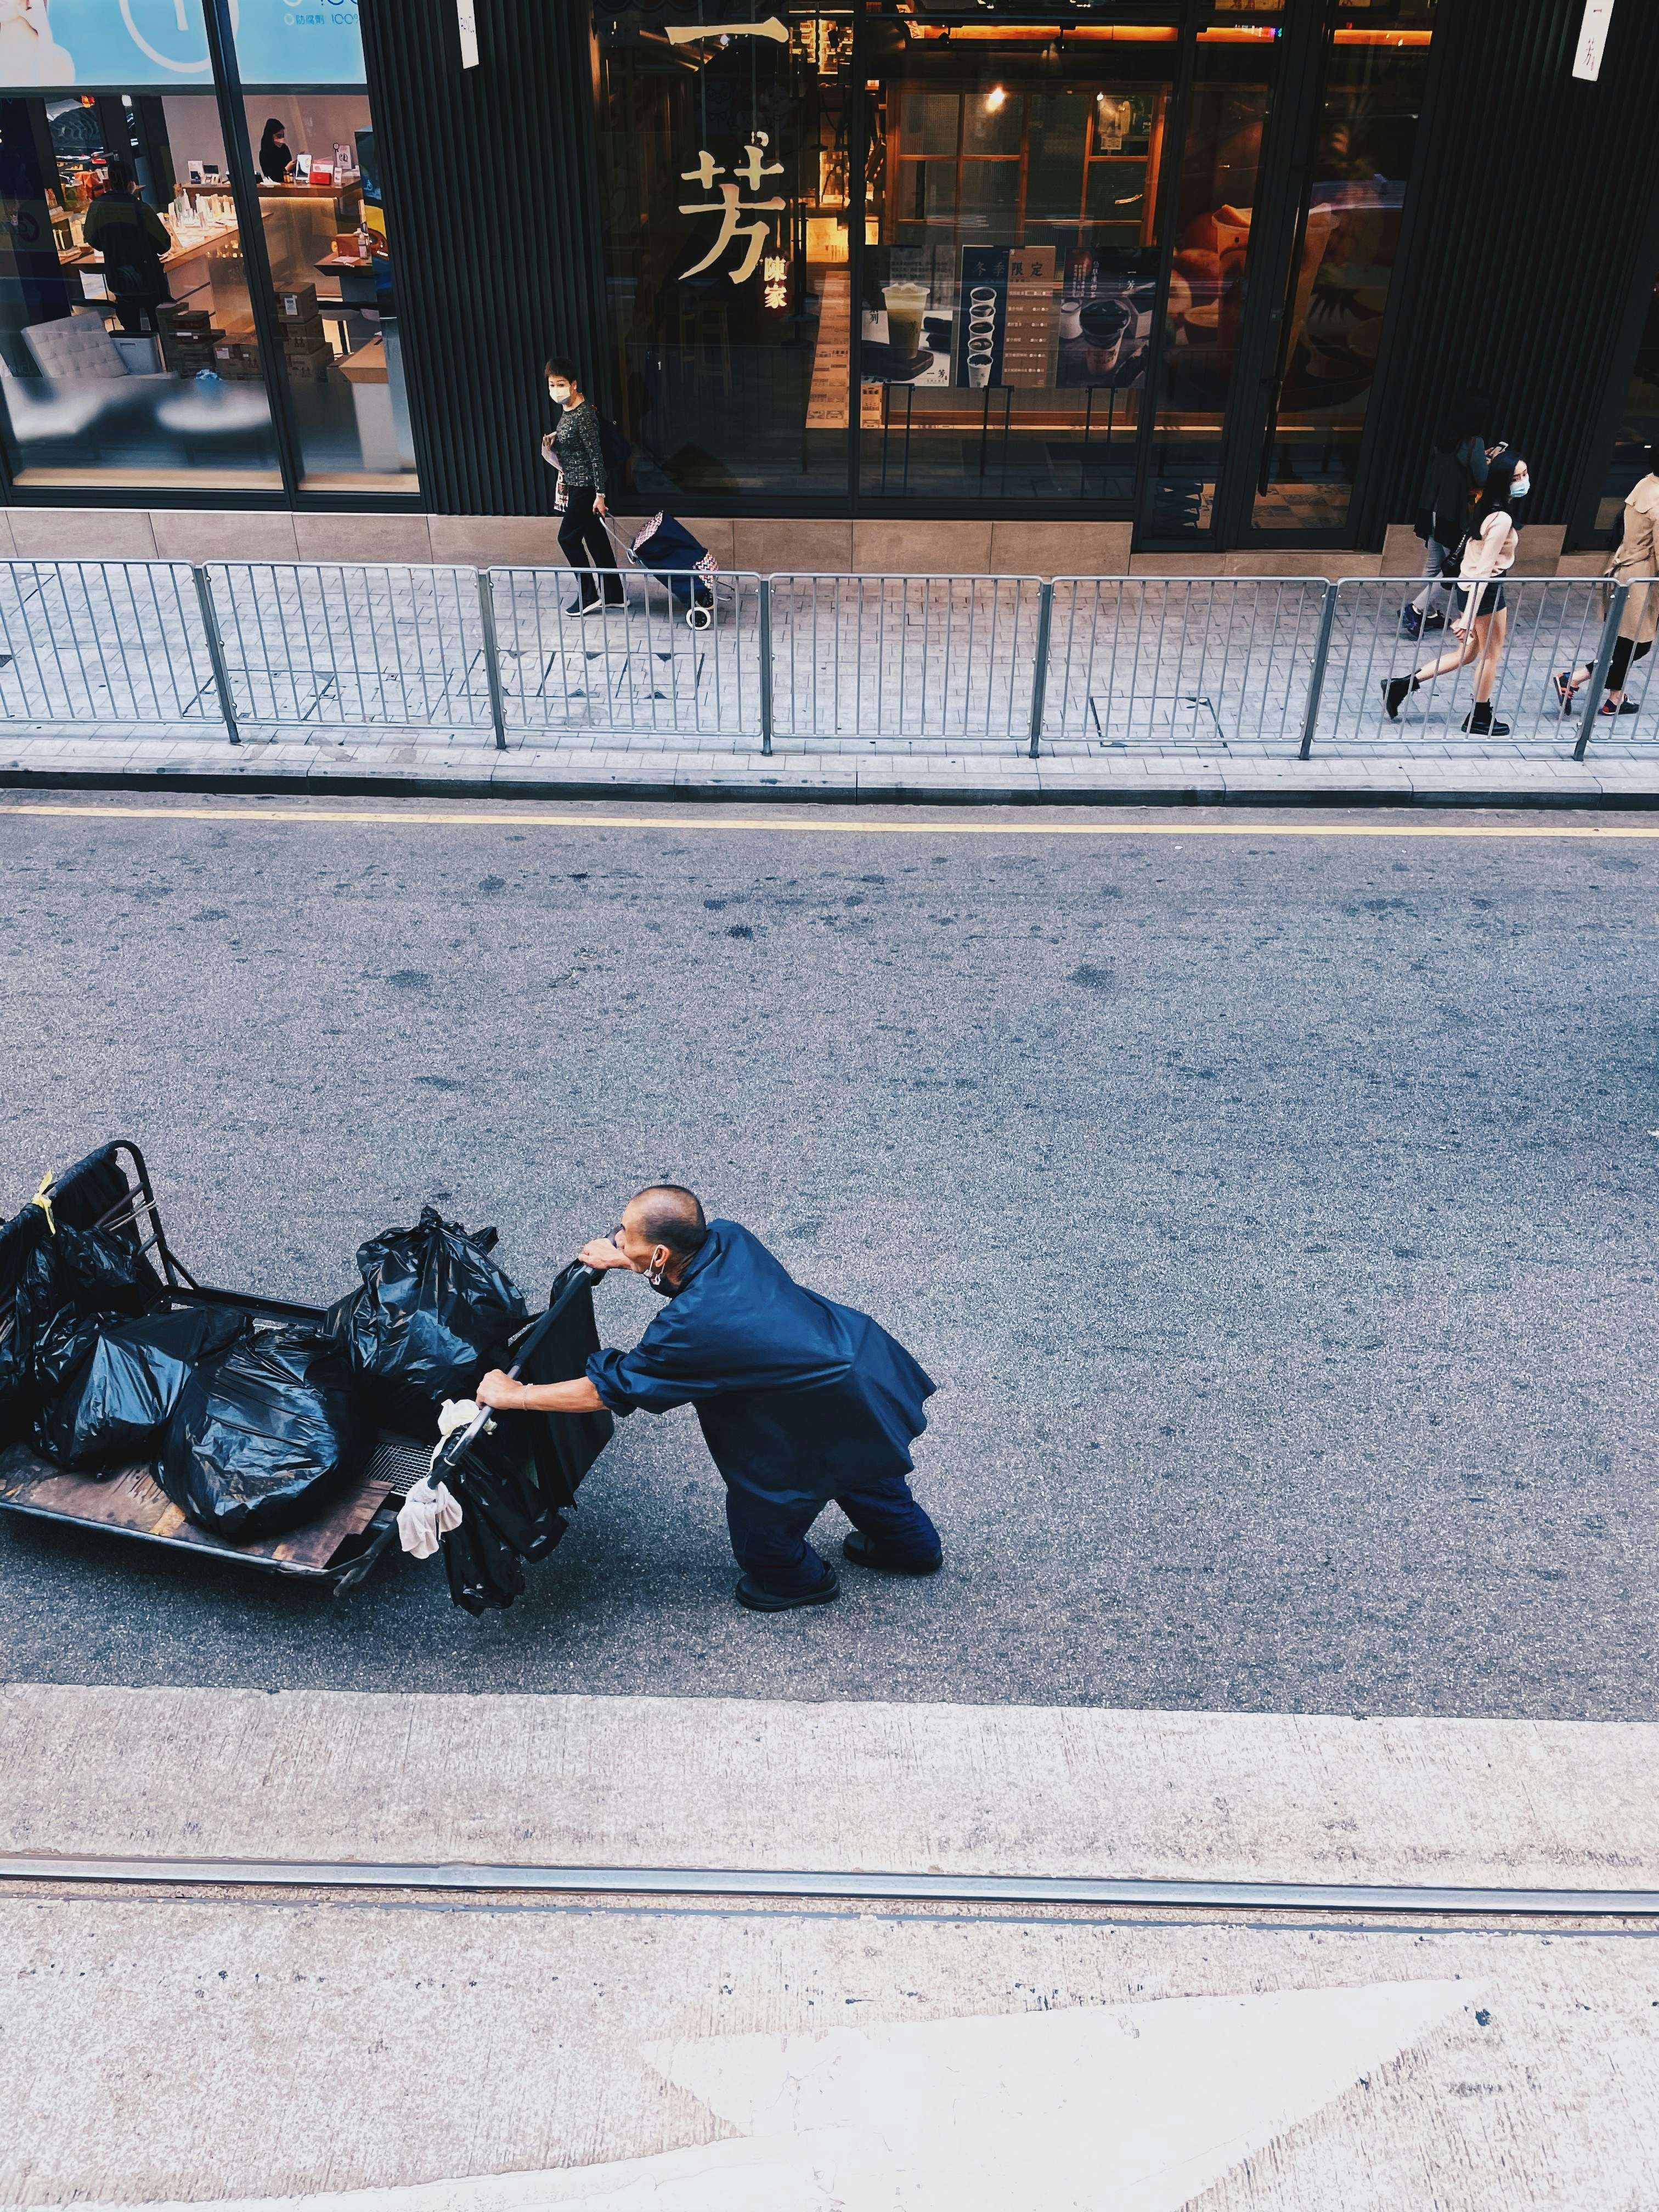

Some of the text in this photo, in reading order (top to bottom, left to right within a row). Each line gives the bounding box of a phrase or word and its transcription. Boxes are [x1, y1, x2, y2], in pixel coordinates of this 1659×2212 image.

[664, 16, 789, 284] 一芳
[973, 261, 1043, 277] 冬季限定
[764, 256, 787, 309] 陳家
[1126, 271, 1137, 290] 一芳
[927, 369, 946, 379] 一芳
